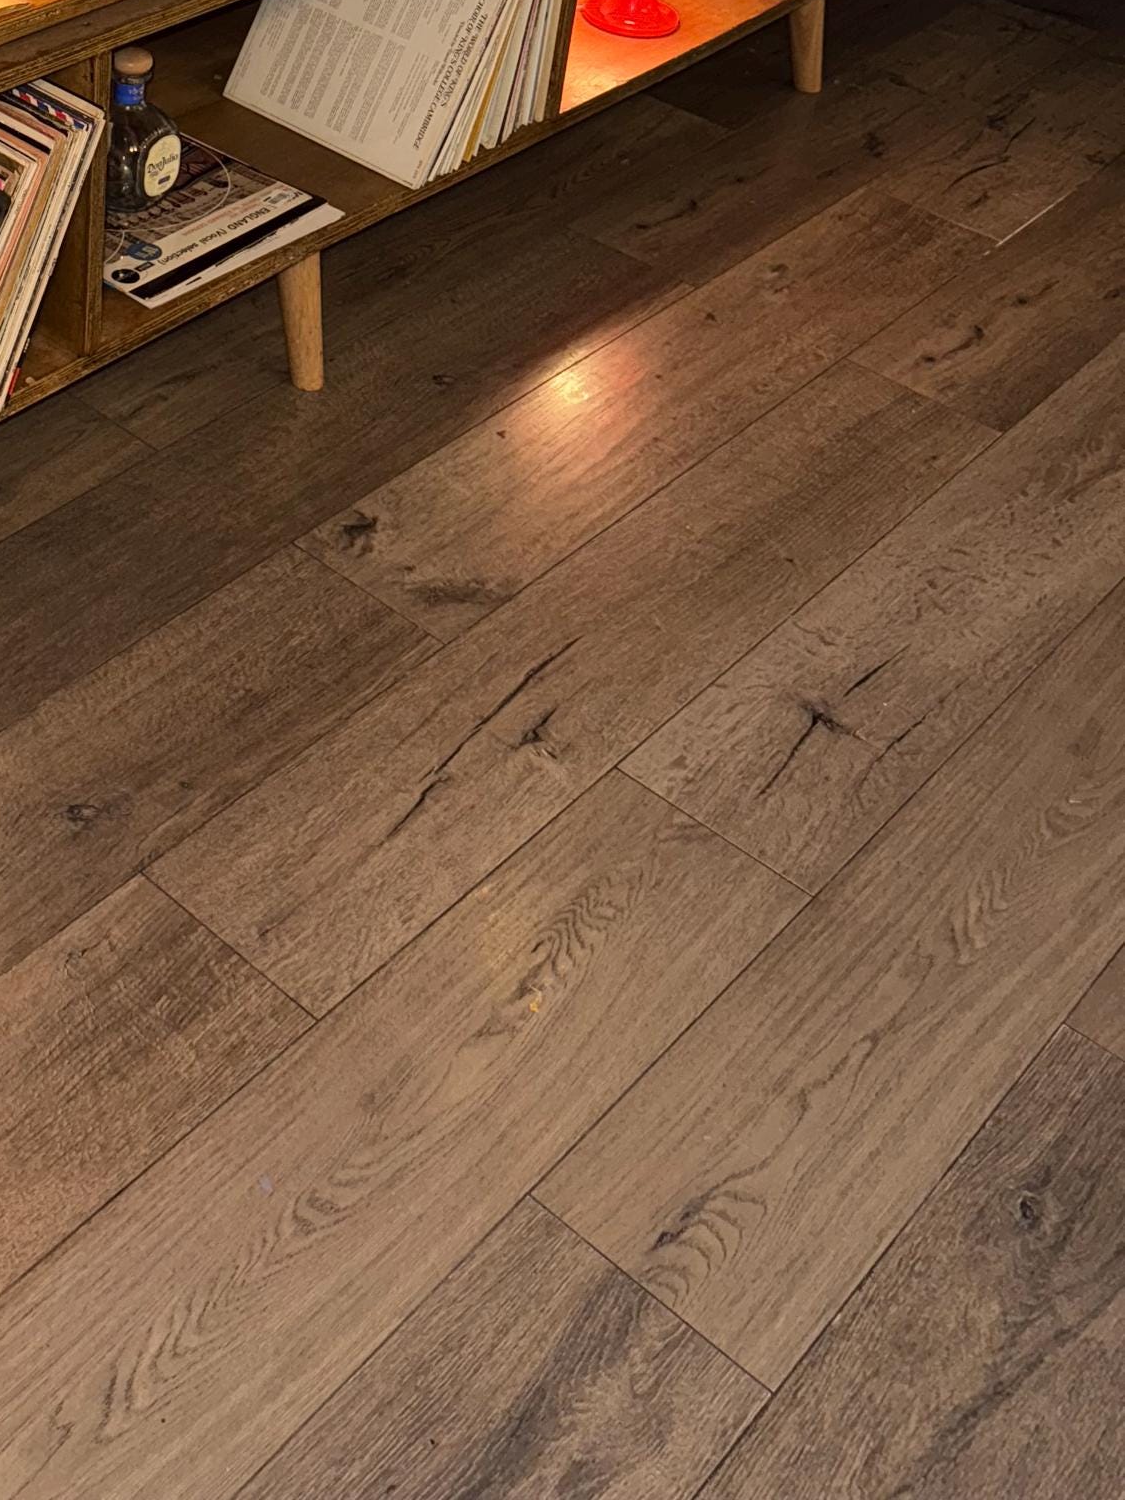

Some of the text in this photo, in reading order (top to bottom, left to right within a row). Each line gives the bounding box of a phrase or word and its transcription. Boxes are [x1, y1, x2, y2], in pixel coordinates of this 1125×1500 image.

[465, 21, 475, 34] OF
[475, 12, 489, 31] THE
[456, 64, 465, 76] OF
[414, 101, 439, 151] CAMBRIDGE
[227, 208, 271, 231] ENGLAND
[199, 227, 228, 246] (Vocal
[157, 242, 199, 266] selection)
